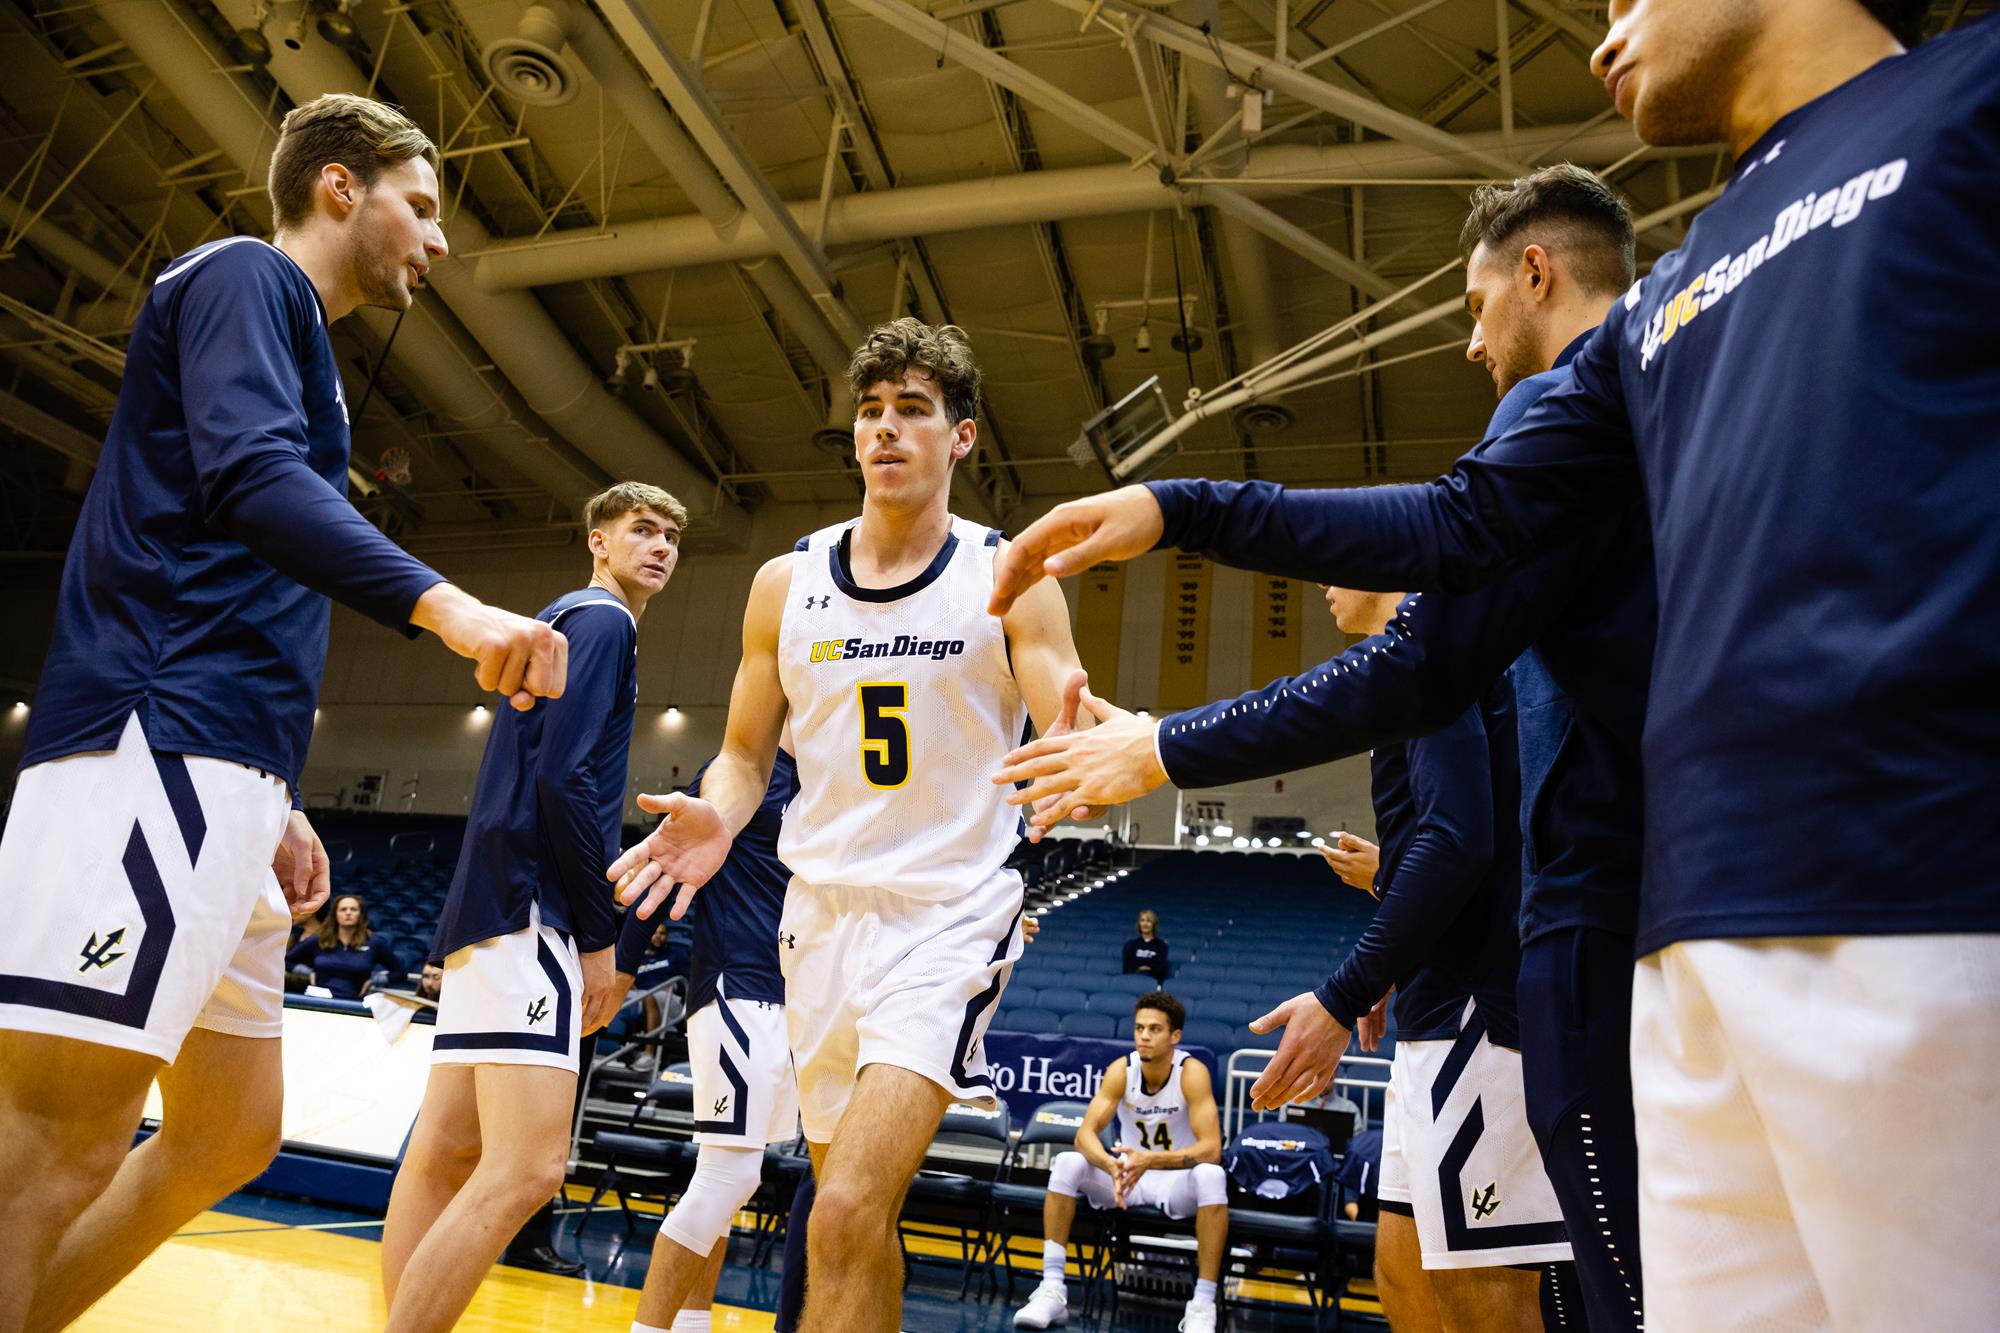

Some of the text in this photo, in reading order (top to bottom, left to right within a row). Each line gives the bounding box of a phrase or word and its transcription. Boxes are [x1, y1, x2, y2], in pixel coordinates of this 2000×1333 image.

[856, 681, 912, 790] 5
[1018, 1056, 1108, 1098] Healt
[1135, 1120, 1173, 1152] 14
